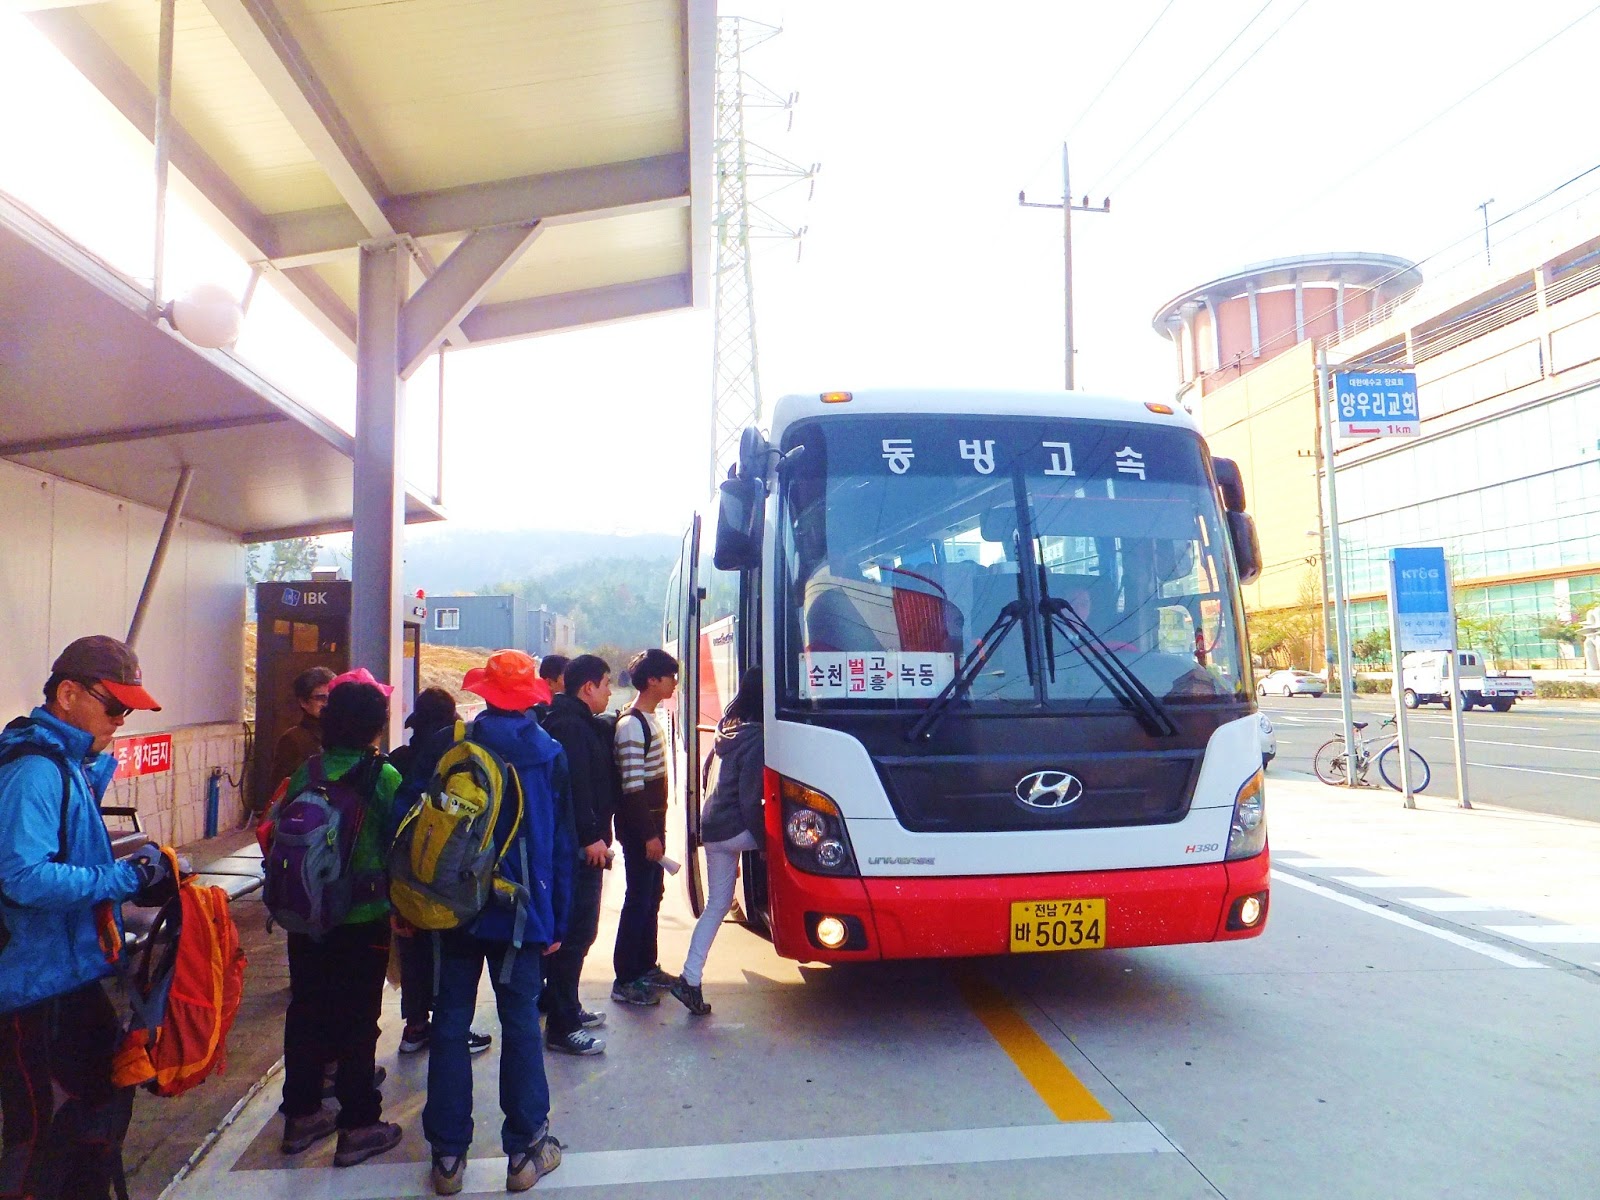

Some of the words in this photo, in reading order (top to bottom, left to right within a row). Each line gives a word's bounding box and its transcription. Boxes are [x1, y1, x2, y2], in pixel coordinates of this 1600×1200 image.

[1340, 391, 1417, 418] 양우리교회
[881, 439, 1147, 481] 동방고속
[1402, 567, 1440, 580] KT&G
[303, 591, 327, 605] IBK
[809, 663, 843, 687] 순천
[848, 658, 866, 692] 벌교
[869, 656, 887, 692] 고흥
[900, 663, 935, 687] 녹동
[1185, 843, 1219, 854] H380
[1034, 903, 1058, 918] 전남
[1062, 902, 1083, 916] 74
[1035, 918, 1101, 947] 5034
